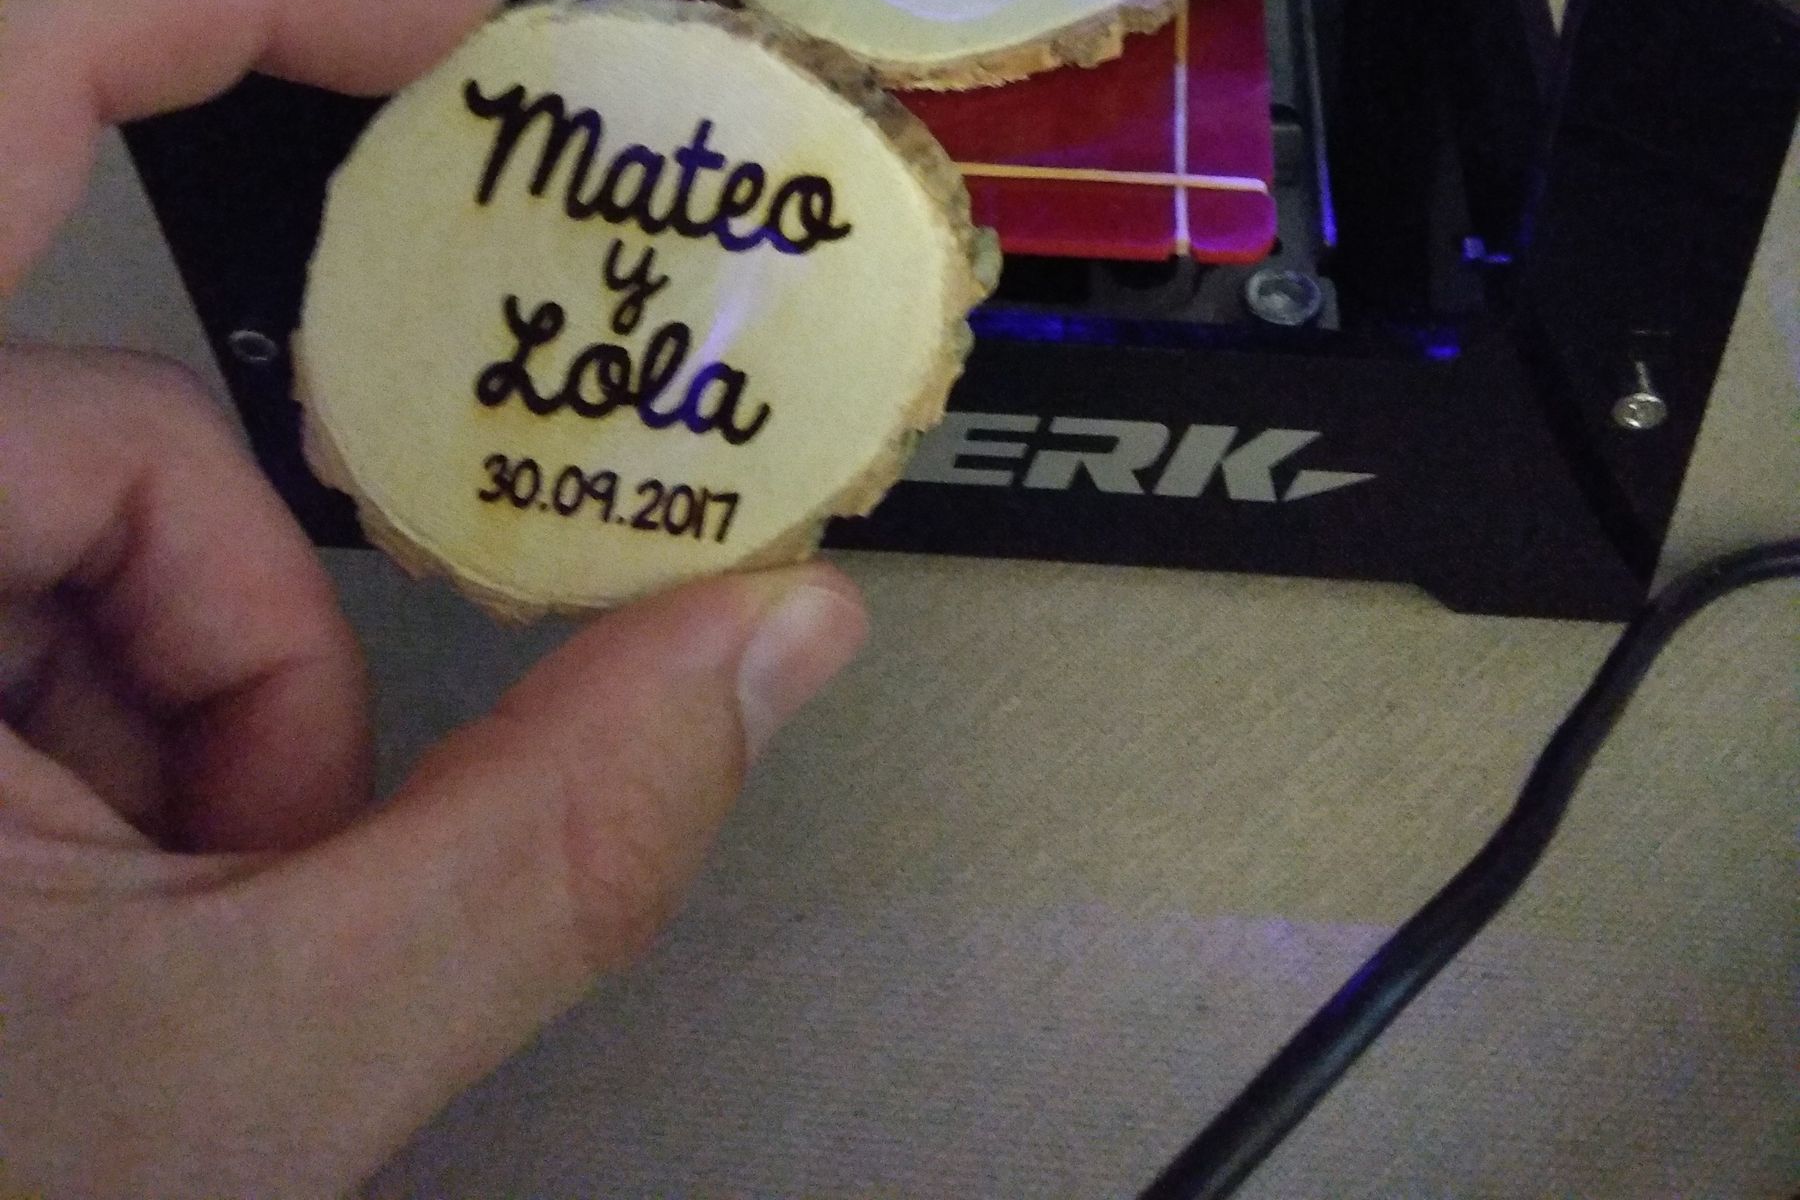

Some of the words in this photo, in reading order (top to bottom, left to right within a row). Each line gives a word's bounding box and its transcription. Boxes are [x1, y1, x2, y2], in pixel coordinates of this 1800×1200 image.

[463, 79, 852, 255] Mateo
[604, 239, 669, 336] y
[474, 295, 770, 445] Lola
[478, 453, 741, 543] 30.09.2017
